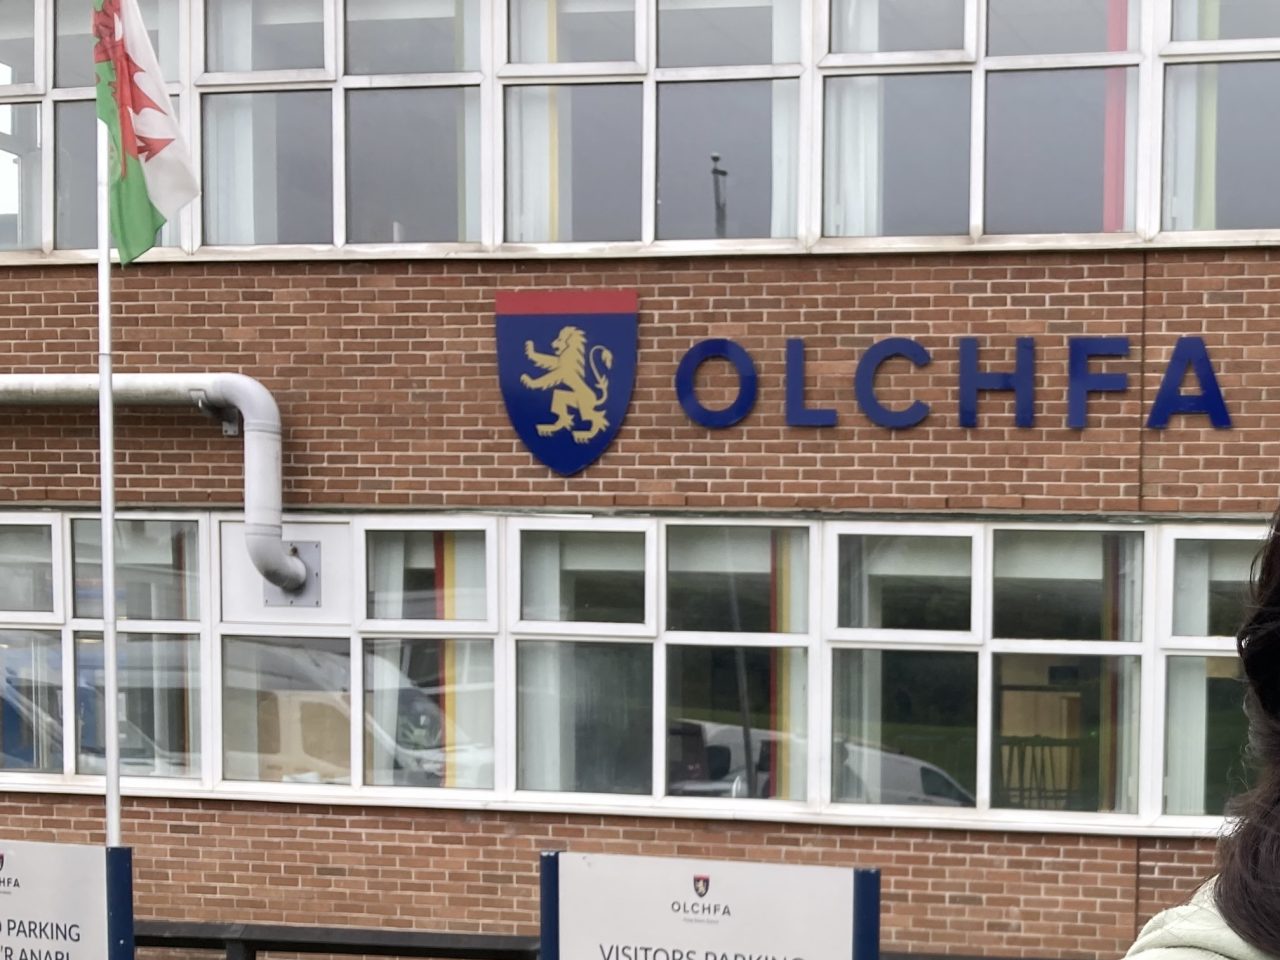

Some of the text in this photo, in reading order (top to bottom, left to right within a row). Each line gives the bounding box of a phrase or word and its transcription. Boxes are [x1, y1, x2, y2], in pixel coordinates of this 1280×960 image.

[674, 336, 1234, 430] OLCHFA
[0, 877, 20, 888] HFA
[671, 900, 731, 916] OLCHFA
[7, 918, 80, 943] PARKING
